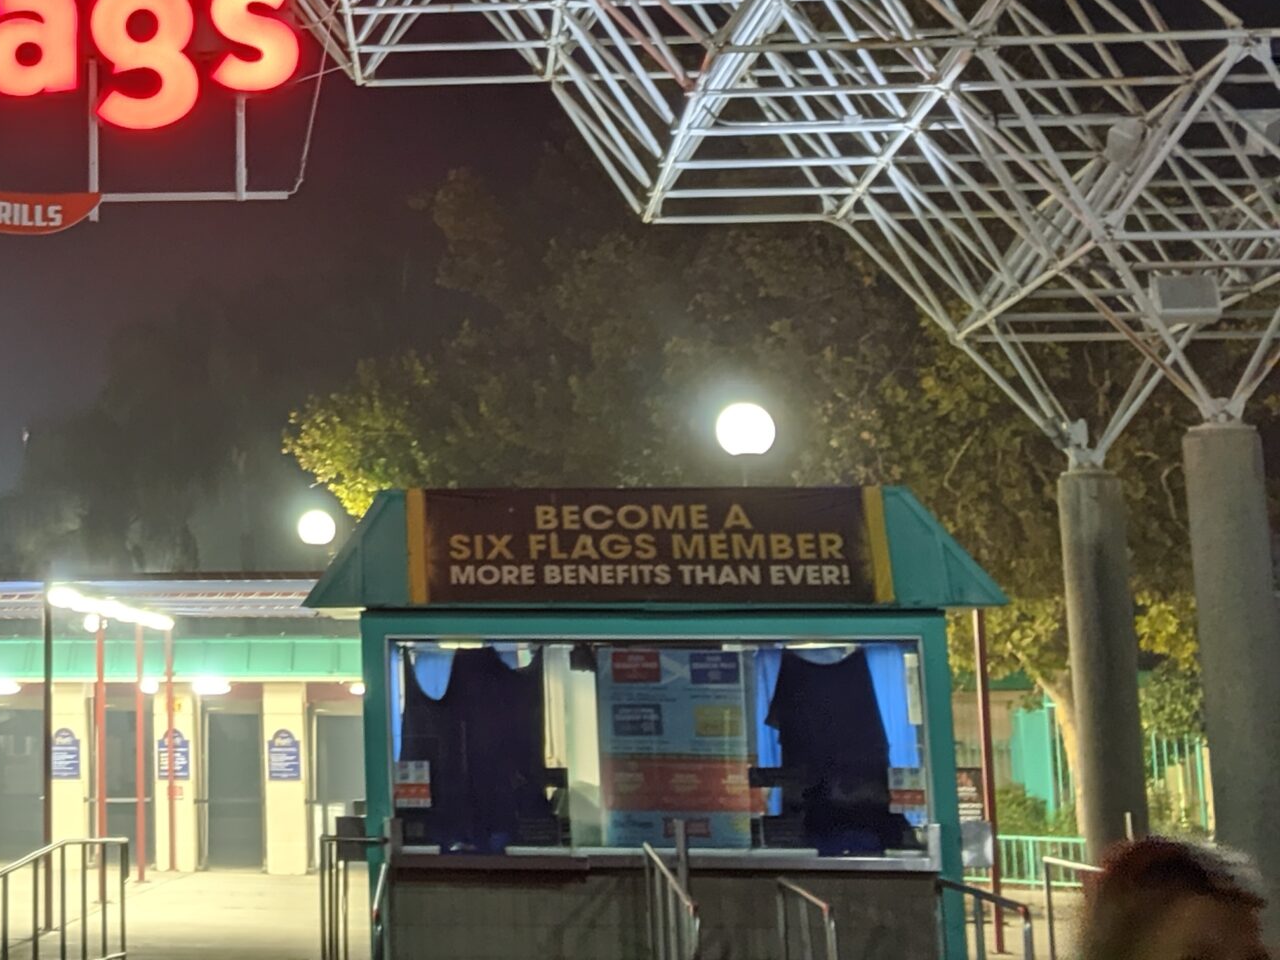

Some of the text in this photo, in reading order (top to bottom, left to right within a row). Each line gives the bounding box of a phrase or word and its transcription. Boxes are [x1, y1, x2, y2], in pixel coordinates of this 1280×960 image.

[535, 504, 753, 530] BECOME A
[449, 533, 845, 560] SIX FLAGS MEMBER
[450, 564, 851, 586] MORE BENEFITS THAN EVER!
